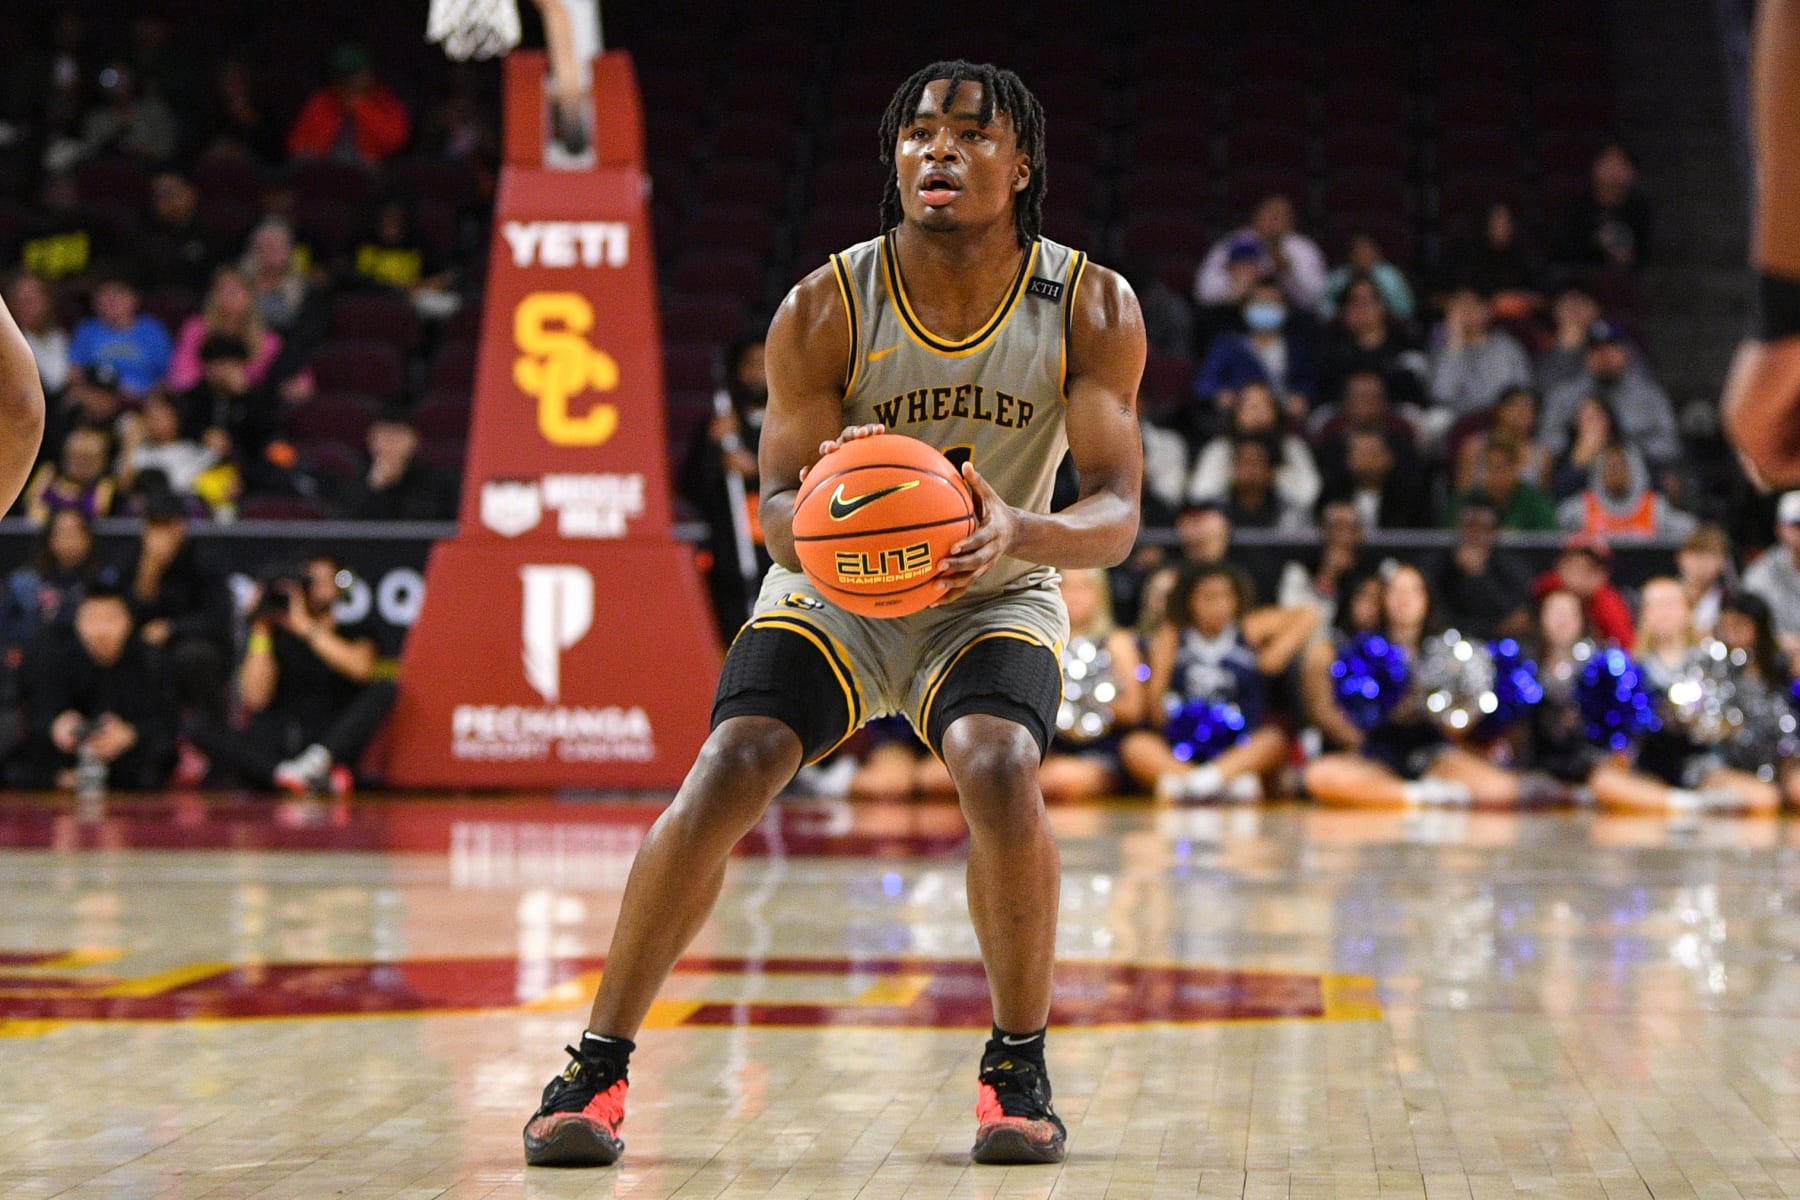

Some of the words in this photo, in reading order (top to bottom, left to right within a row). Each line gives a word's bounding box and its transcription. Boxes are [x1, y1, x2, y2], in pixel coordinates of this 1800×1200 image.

[503, 222, 629, 267] YETI
[514, 292, 620, 447] SC
[873, 383, 1035, 430] WHEELER
[835, 540, 932, 576] ELITE
[839, 565, 932, 584] CHAMPIONSHIP
[453, 706, 653, 740] PECHANGA
